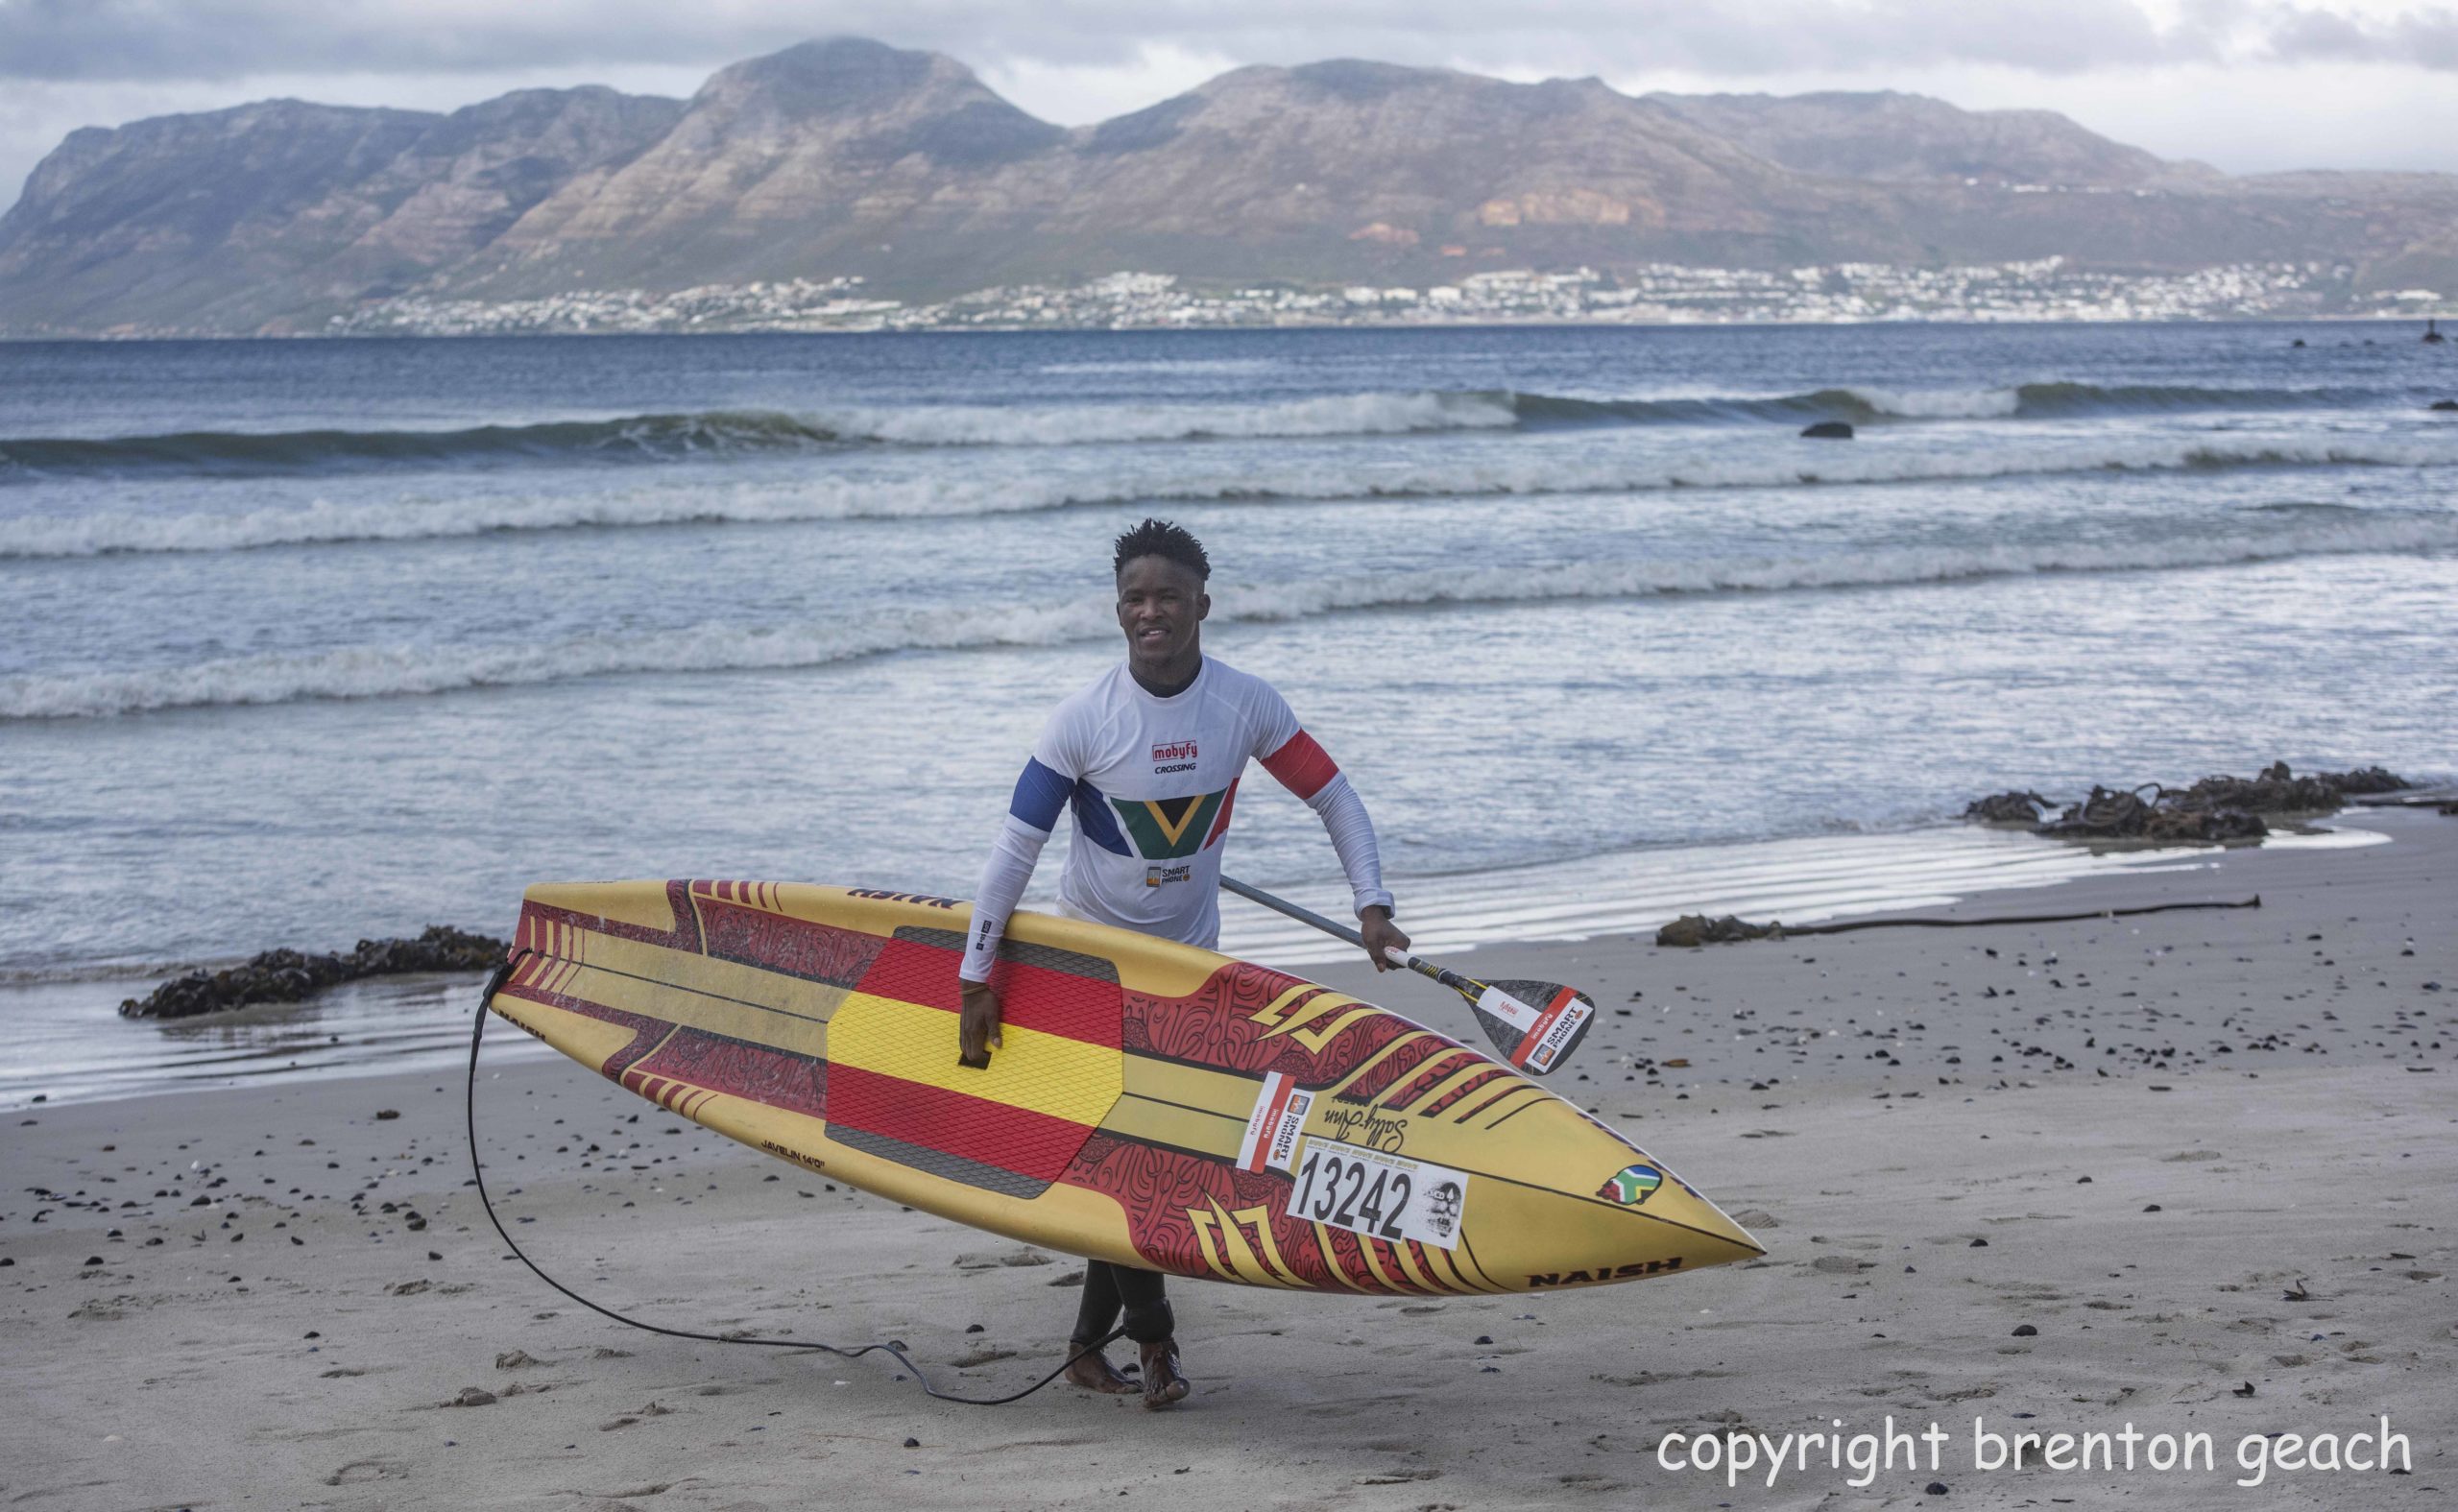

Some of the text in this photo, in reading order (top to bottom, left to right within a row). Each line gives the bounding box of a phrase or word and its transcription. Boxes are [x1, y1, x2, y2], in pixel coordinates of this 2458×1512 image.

[1154, 742, 1198, 759] mobyfy
[1154, 762, 1196, 775] CROSSING
[1162, 865, 1191, 877] SMART
[1162, 875, 1183, 883] PHONE
[1547, 1006, 1578, 1045] SMART
[1552, 1019, 1577, 1049] PHONE
[1276, 1115, 1291, 1149] PHONE
[1279, 1116, 1299, 1162] SMART
[761, 1140, 801, 1161] JAVELIN
[1297, 1152, 1411, 1240] 13242
[1524, 1257, 1683, 1288] NAISH
